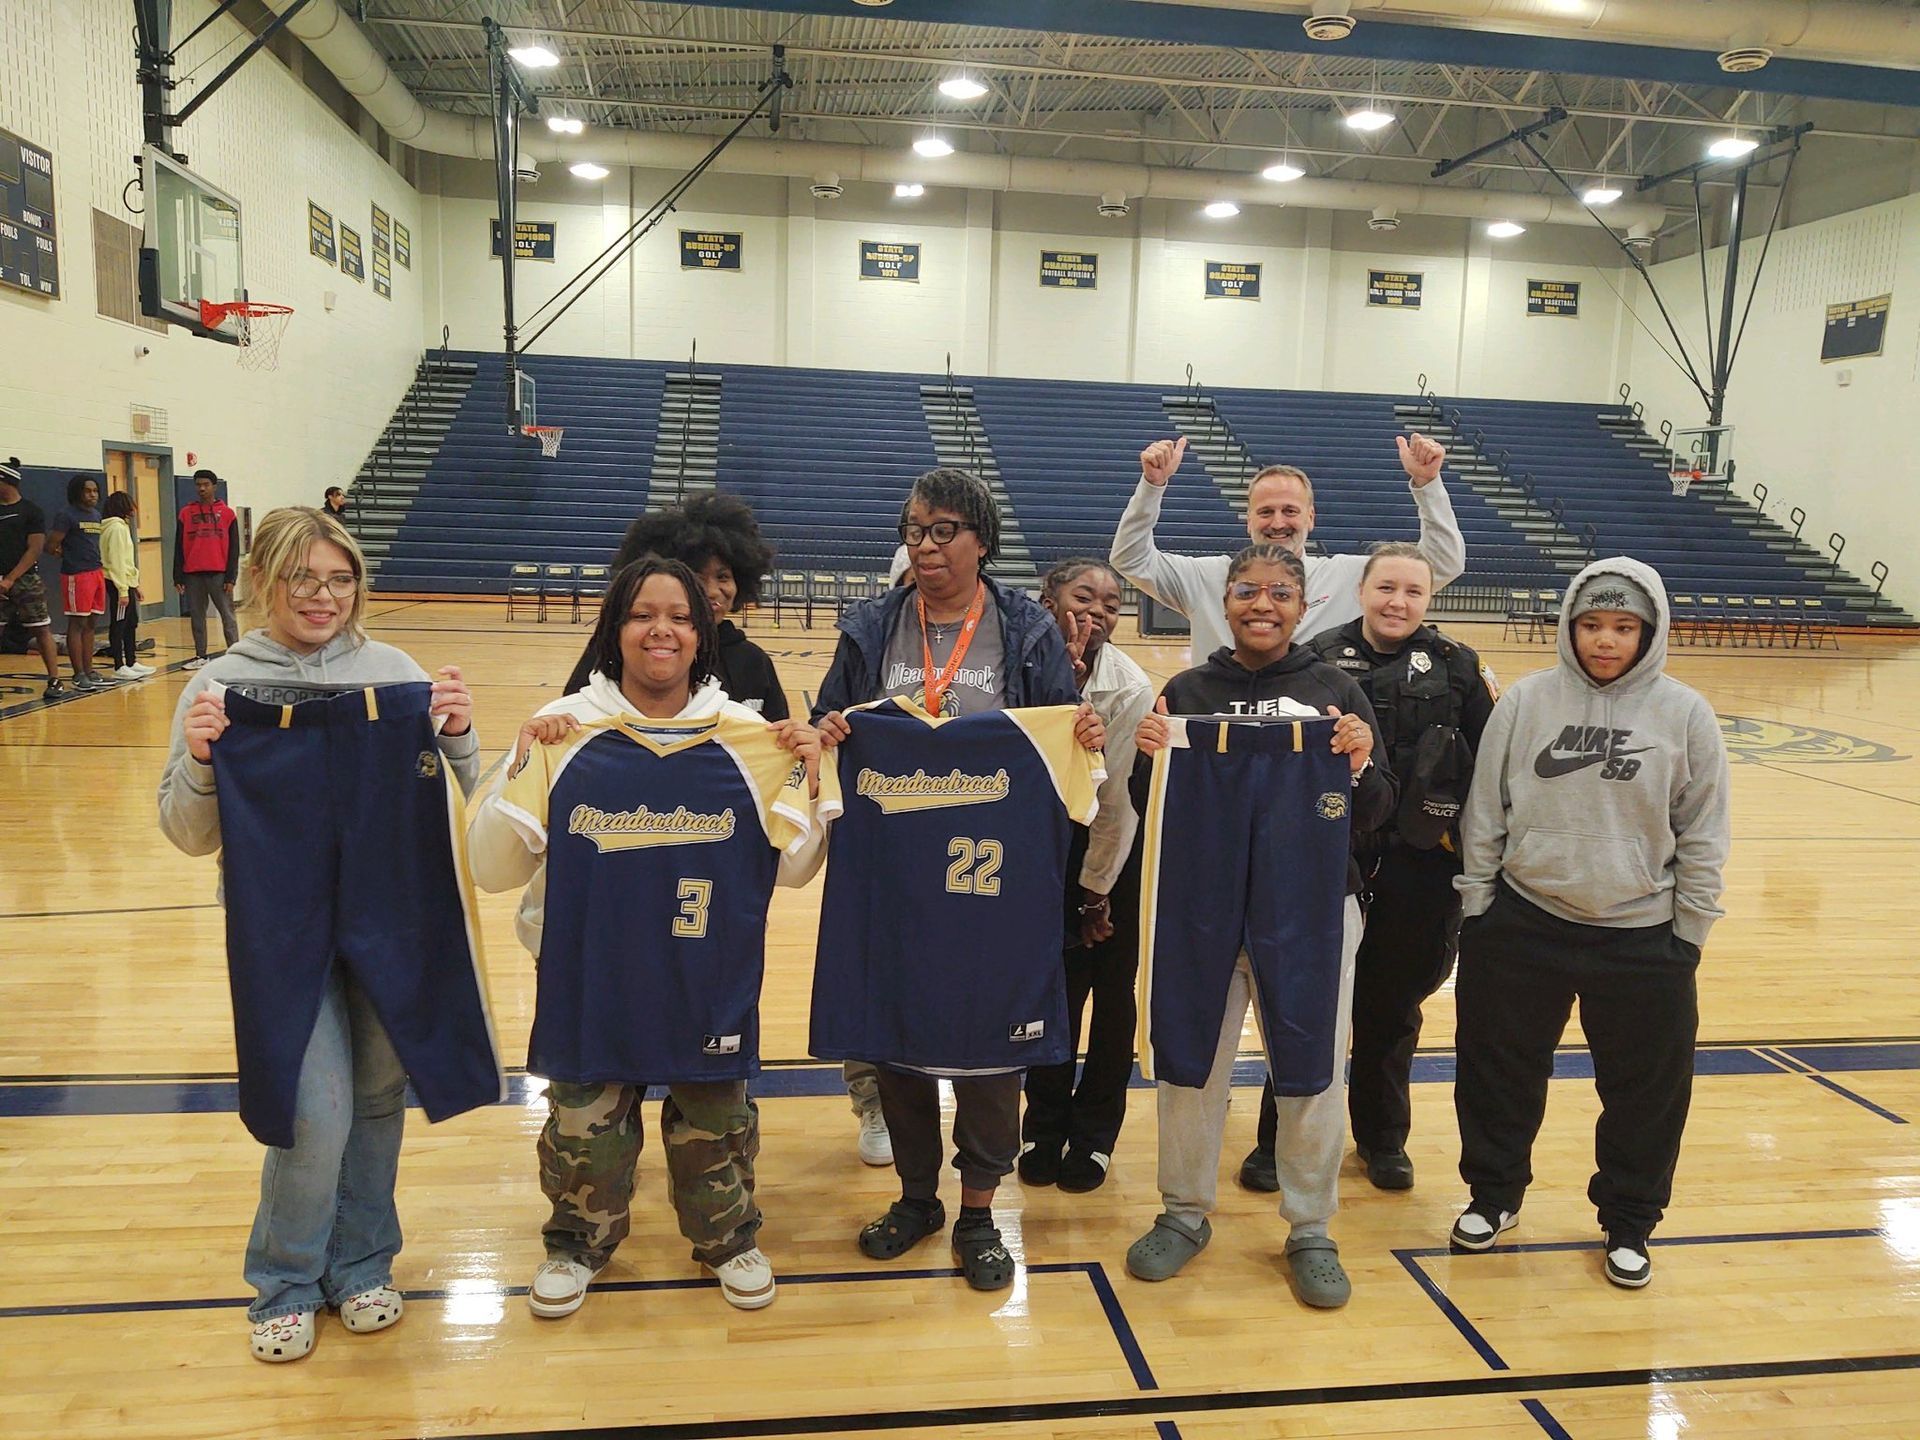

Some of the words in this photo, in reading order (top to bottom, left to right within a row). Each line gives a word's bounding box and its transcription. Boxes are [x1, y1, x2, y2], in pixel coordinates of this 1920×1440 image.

[20, 146, 51, 175] VISITOR
[23, 209, 42, 229] BONUS
[0, 222, 18, 241] FOULS
[697, 234, 724, 243] STATE
[36, 236, 53, 253] FOULS
[877, 244, 904, 253] STATE
[698, 251, 723, 259] GOLF
[1056, 254, 1082, 262] STATE
[878, 261, 902, 269] GOLF
[1043, 261, 1095, 271] CHAMPIONS
[1221, 264, 1246, 273] STATE
[19, 272, 32, 288] TOL
[1209, 271, 1257, 281] CHAMPIONS
[1384, 274, 1409, 282] STATE
[1221, 280, 1244, 288] GOLF
[1542, 283, 1565, 291] STATE
[1544, 298, 1576, 306] BASKETBALL
[1336, 660, 1361, 668] POLICE
[1229, 698, 1278, 716] THE
[1552, 724, 1633, 753] NIKE
[1600, 757, 1642, 782] SB
[857, 767, 1010, 797] Meadowbrook
[1422, 805, 1457, 818] POLICE
[568, 803, 736, 836] Meadowbrook
[945, 836, 1003, 897] 22
[671, 877, 713, 939] 3
